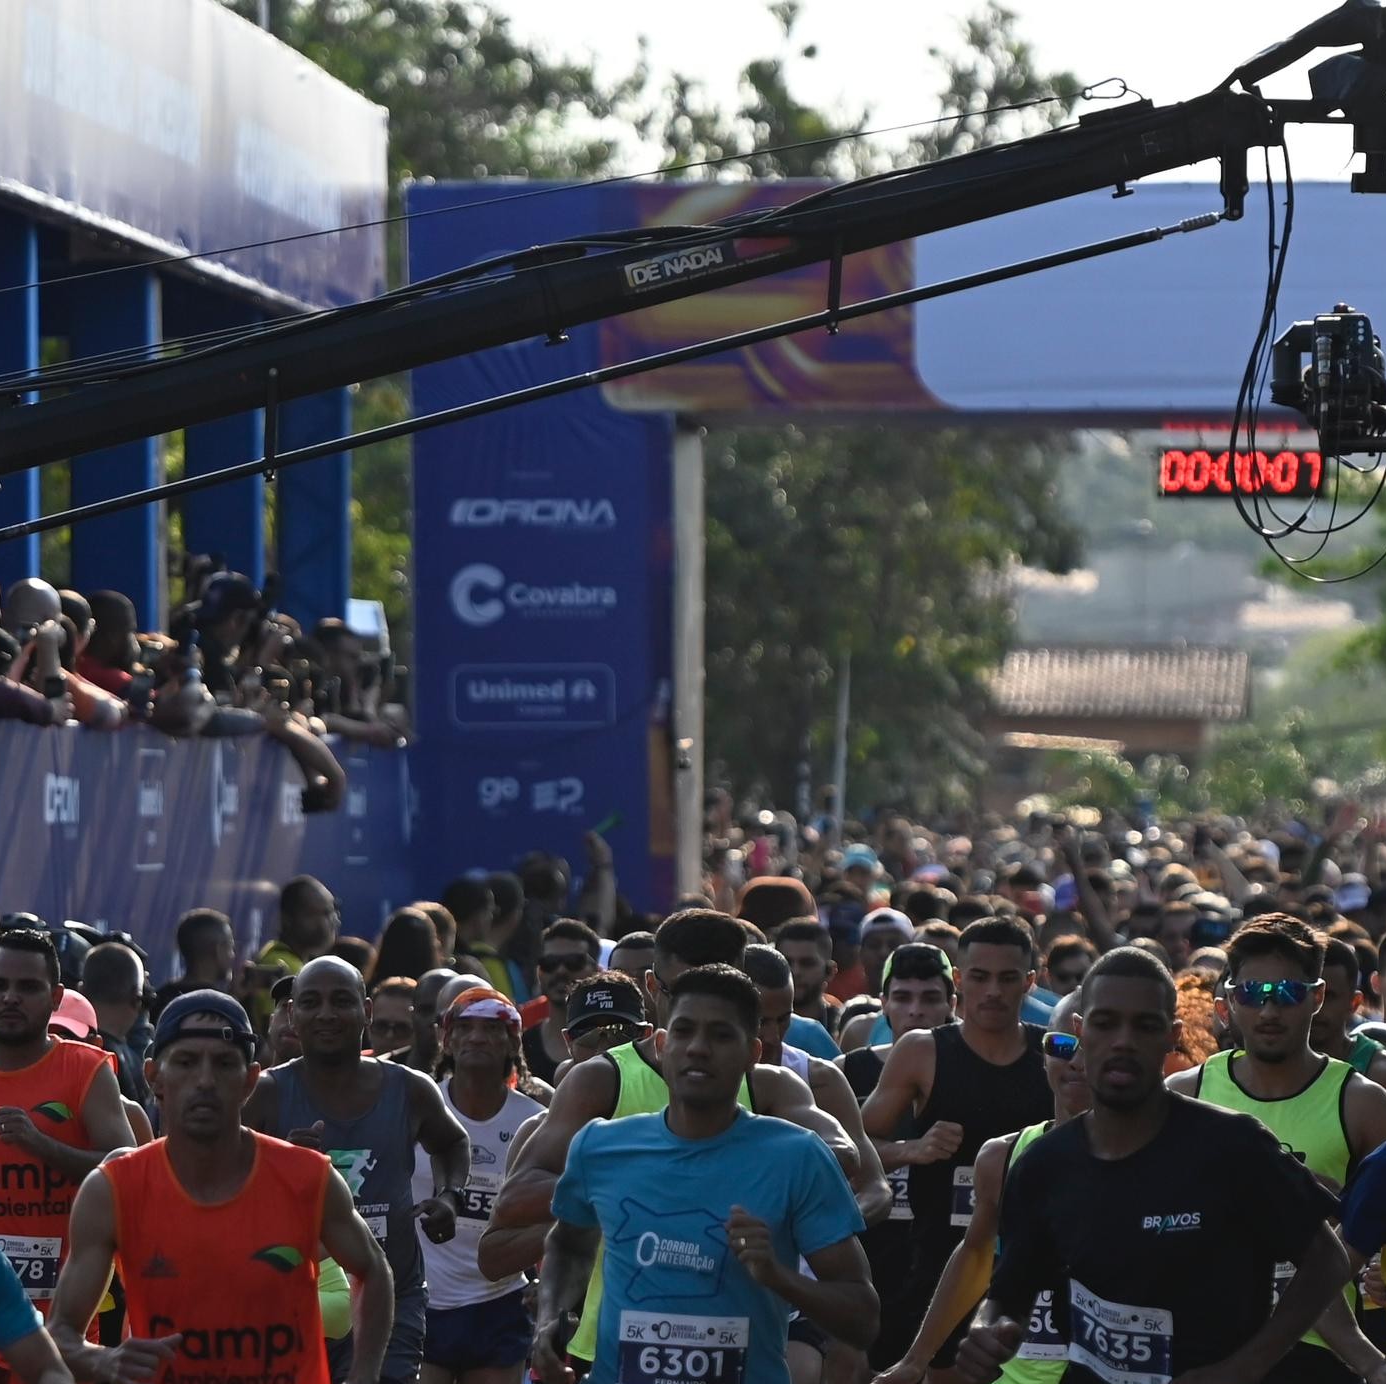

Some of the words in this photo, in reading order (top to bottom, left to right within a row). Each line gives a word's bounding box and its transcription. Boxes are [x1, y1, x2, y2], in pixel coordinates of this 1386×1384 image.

[633, 264, 661, 285] DE
[664, 248, 724, 276] NADAI
[508, 582, 617, 606] Covabra
[468, 679, 566, 702] Unimed
[1143, 1212, 1201, 1233] BRAVOS
[40, 1246, 54, 1256] 5K
[660, 1239, 700, 1255] CORRIDA
[657, 1251, 715, 1271] INTEGRAÇÃO
[1076, 1292, 1087, 1308] 5K
[626, 1325, 646, 1339] 5K
[1144, 1319, 1163, 1331] 5K
[719, 1331, 740, 1344] 5K
[1082, 1316, 1151, 1362] 7635
[639, 1346, 724, 1377] 6301
